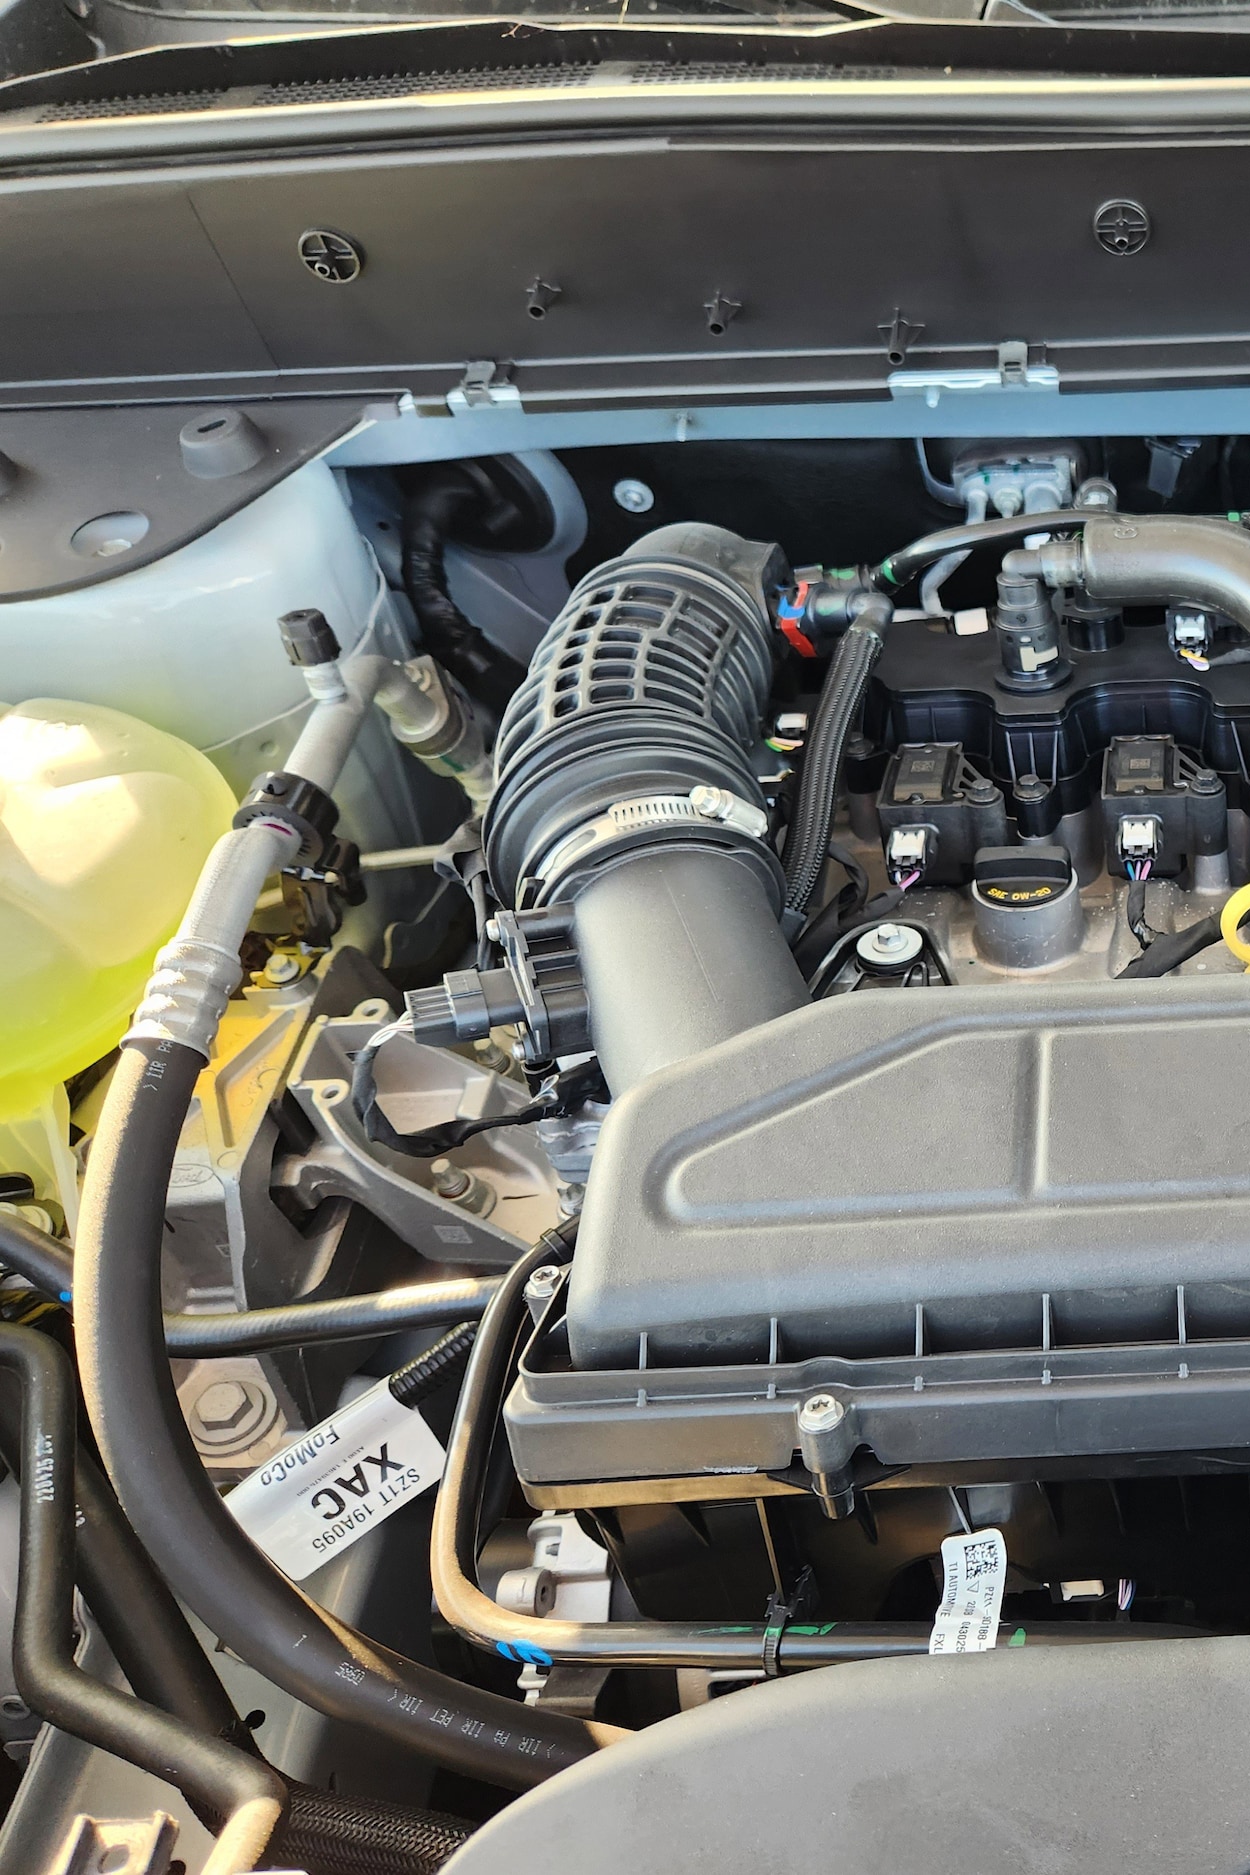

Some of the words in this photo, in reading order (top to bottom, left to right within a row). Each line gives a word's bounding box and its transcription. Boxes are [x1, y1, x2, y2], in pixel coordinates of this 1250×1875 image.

[987, 887, 1008, 899] SAE
[1011, 886, 1051, 900] 0W-20
[260, 1425, 340, 1486] FoMoCo
[311, 1441, 405, 1520] XAC
[379, 1468, 421, 1506] SZ1T
[312, 1503, 375, 1554] 19A095
